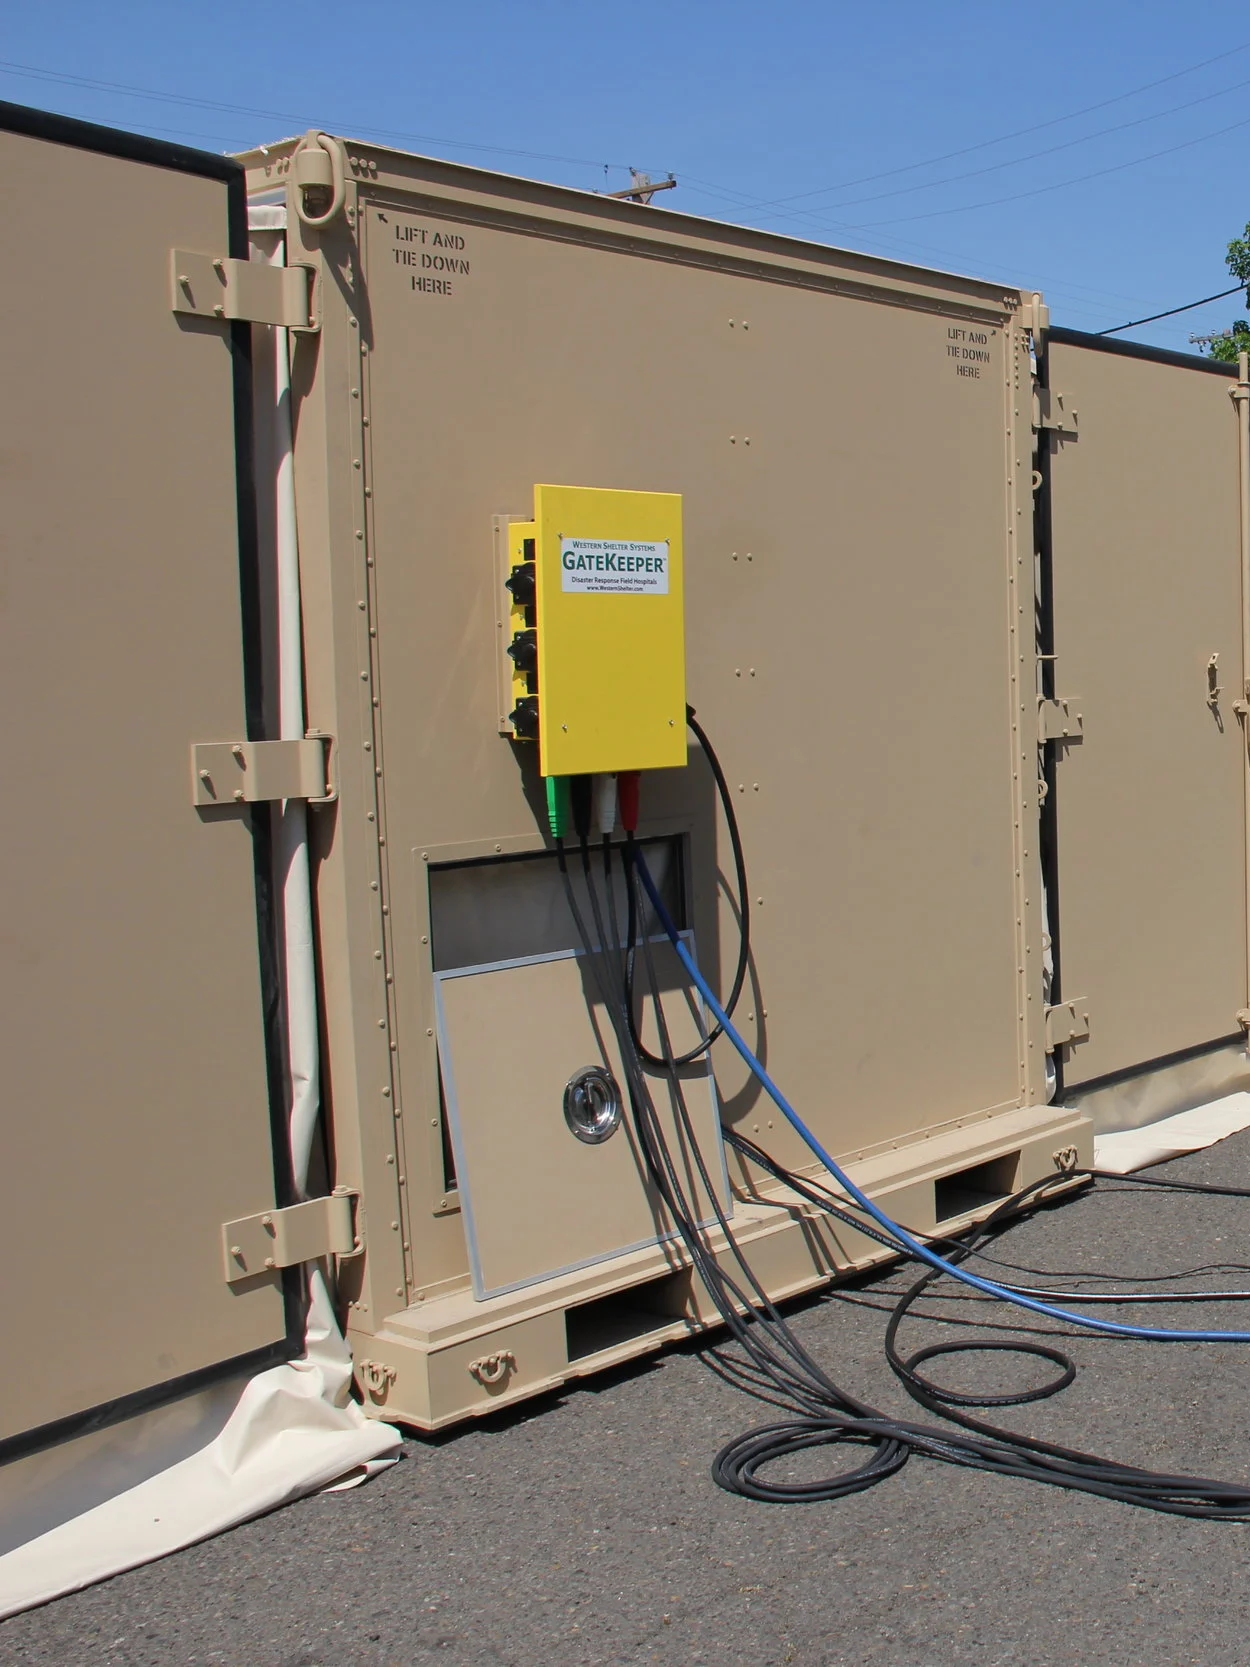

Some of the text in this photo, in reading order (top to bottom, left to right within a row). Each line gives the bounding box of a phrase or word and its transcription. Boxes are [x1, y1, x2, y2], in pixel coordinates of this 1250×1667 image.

[395, 225, 465, 250] LIFT AND
[392, 248, 470, 275] TIE DOWN
[411, 276, 452, 296] HERE
[947, 328, 987, 344] LIFT AND
[946, 345, 990, 363] TIE DOWN
[956, 365, 980, 379] HERE
[571, 576, 657, 586] Disaster Response Field Hospitals
